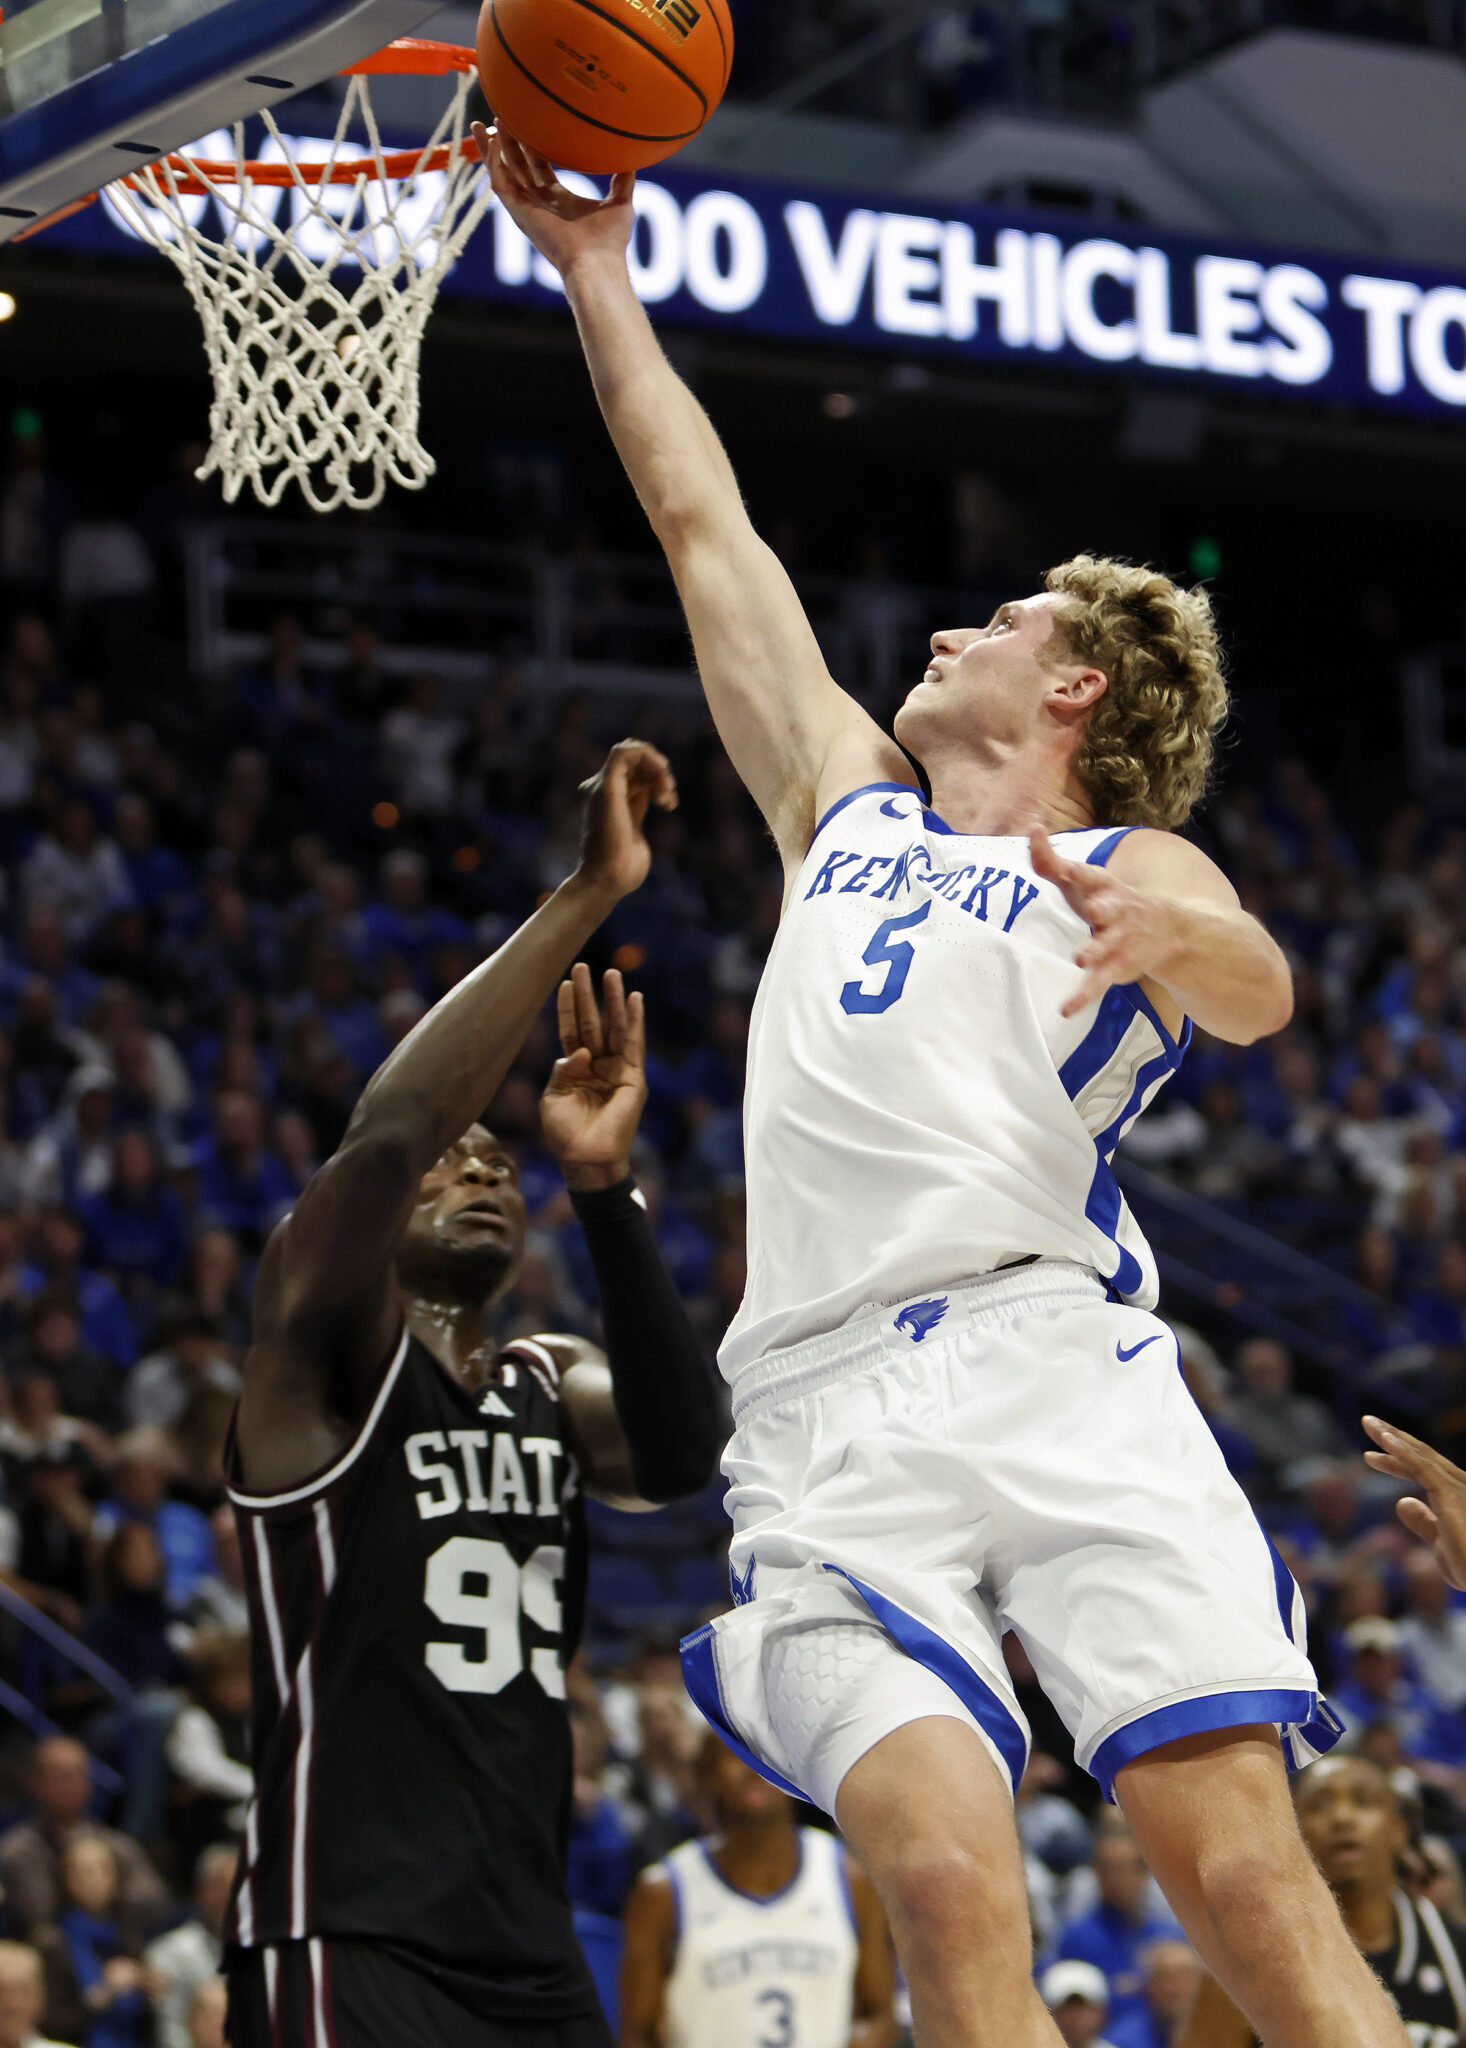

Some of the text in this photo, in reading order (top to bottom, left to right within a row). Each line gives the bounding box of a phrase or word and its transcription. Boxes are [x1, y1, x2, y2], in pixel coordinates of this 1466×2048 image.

[474, 168, 768, 313] 100
[784, 200, 1333, 385] VEHICLES
[803, 841, 1040, 933] KENCKY
[840, 899, 932, 1016] 5
[404, 1430, 579, 1520] STAT
[756, 1988, 796, 2048] 3
